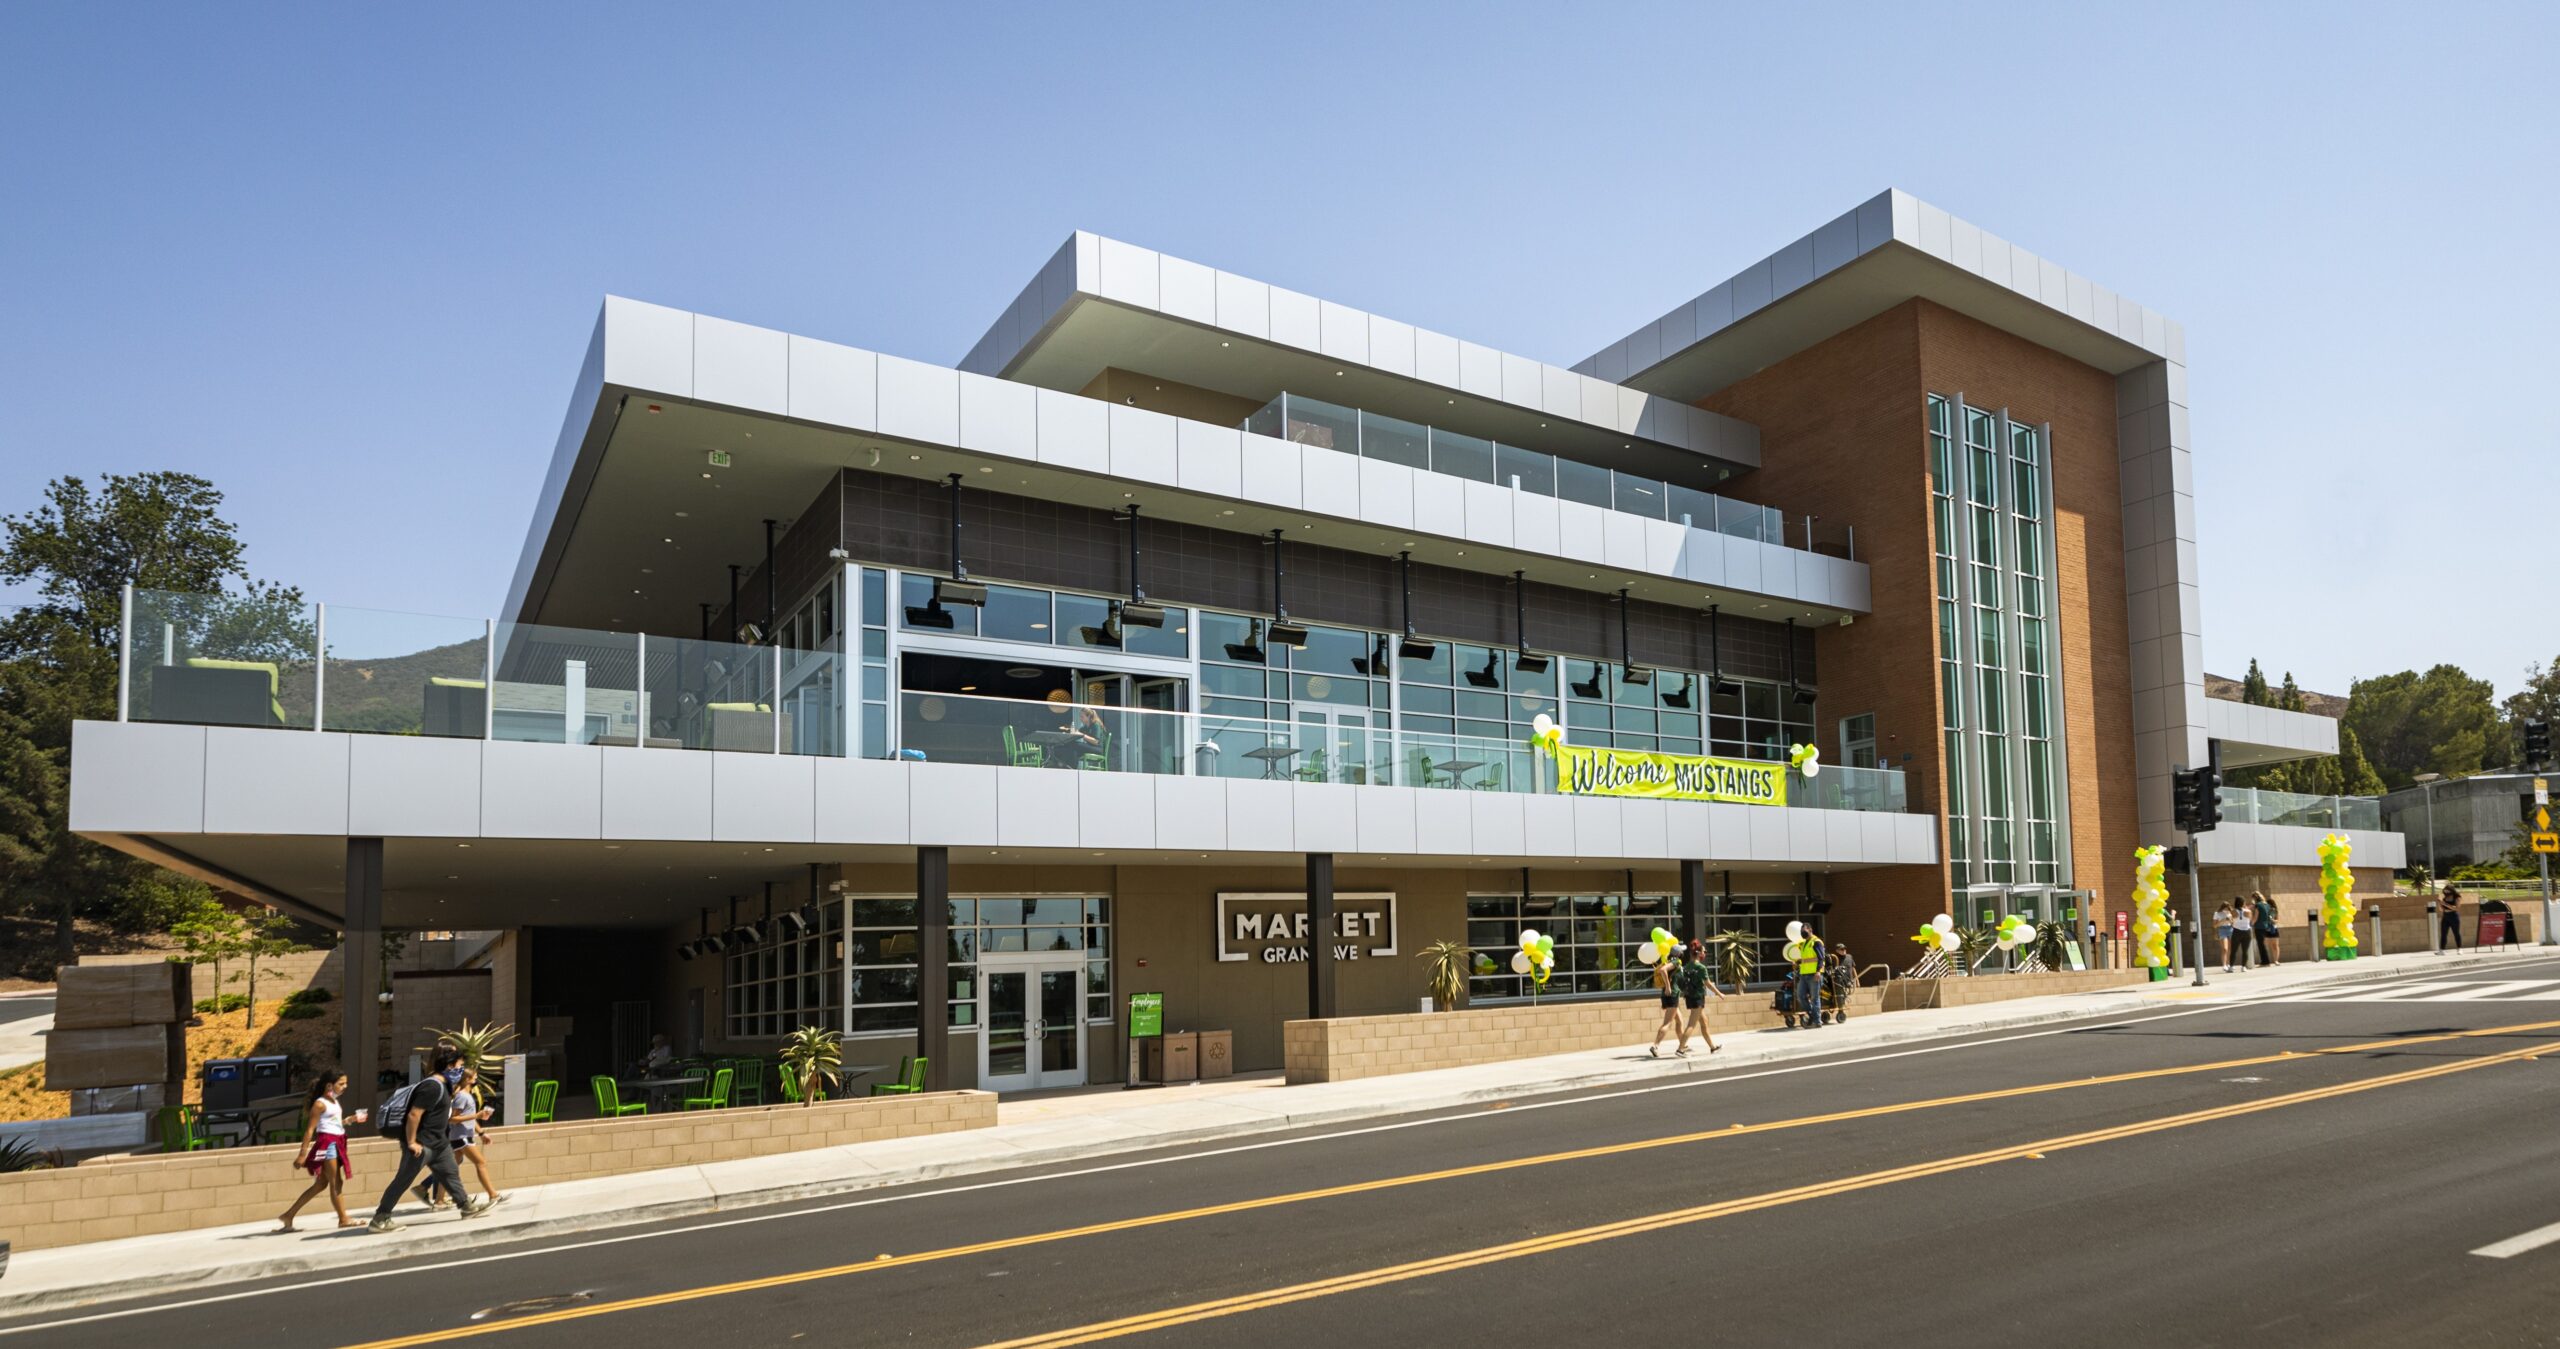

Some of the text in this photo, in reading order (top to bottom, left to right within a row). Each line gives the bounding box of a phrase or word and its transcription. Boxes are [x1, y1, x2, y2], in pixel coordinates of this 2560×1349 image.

[712, 452, 727, 464] EXIT
[1571, 750, 1774, 799] Welcome MUSTANGS
[1236, 912, 1381, 940] MARET
[1263, 946, 1310, 963] GRAN
